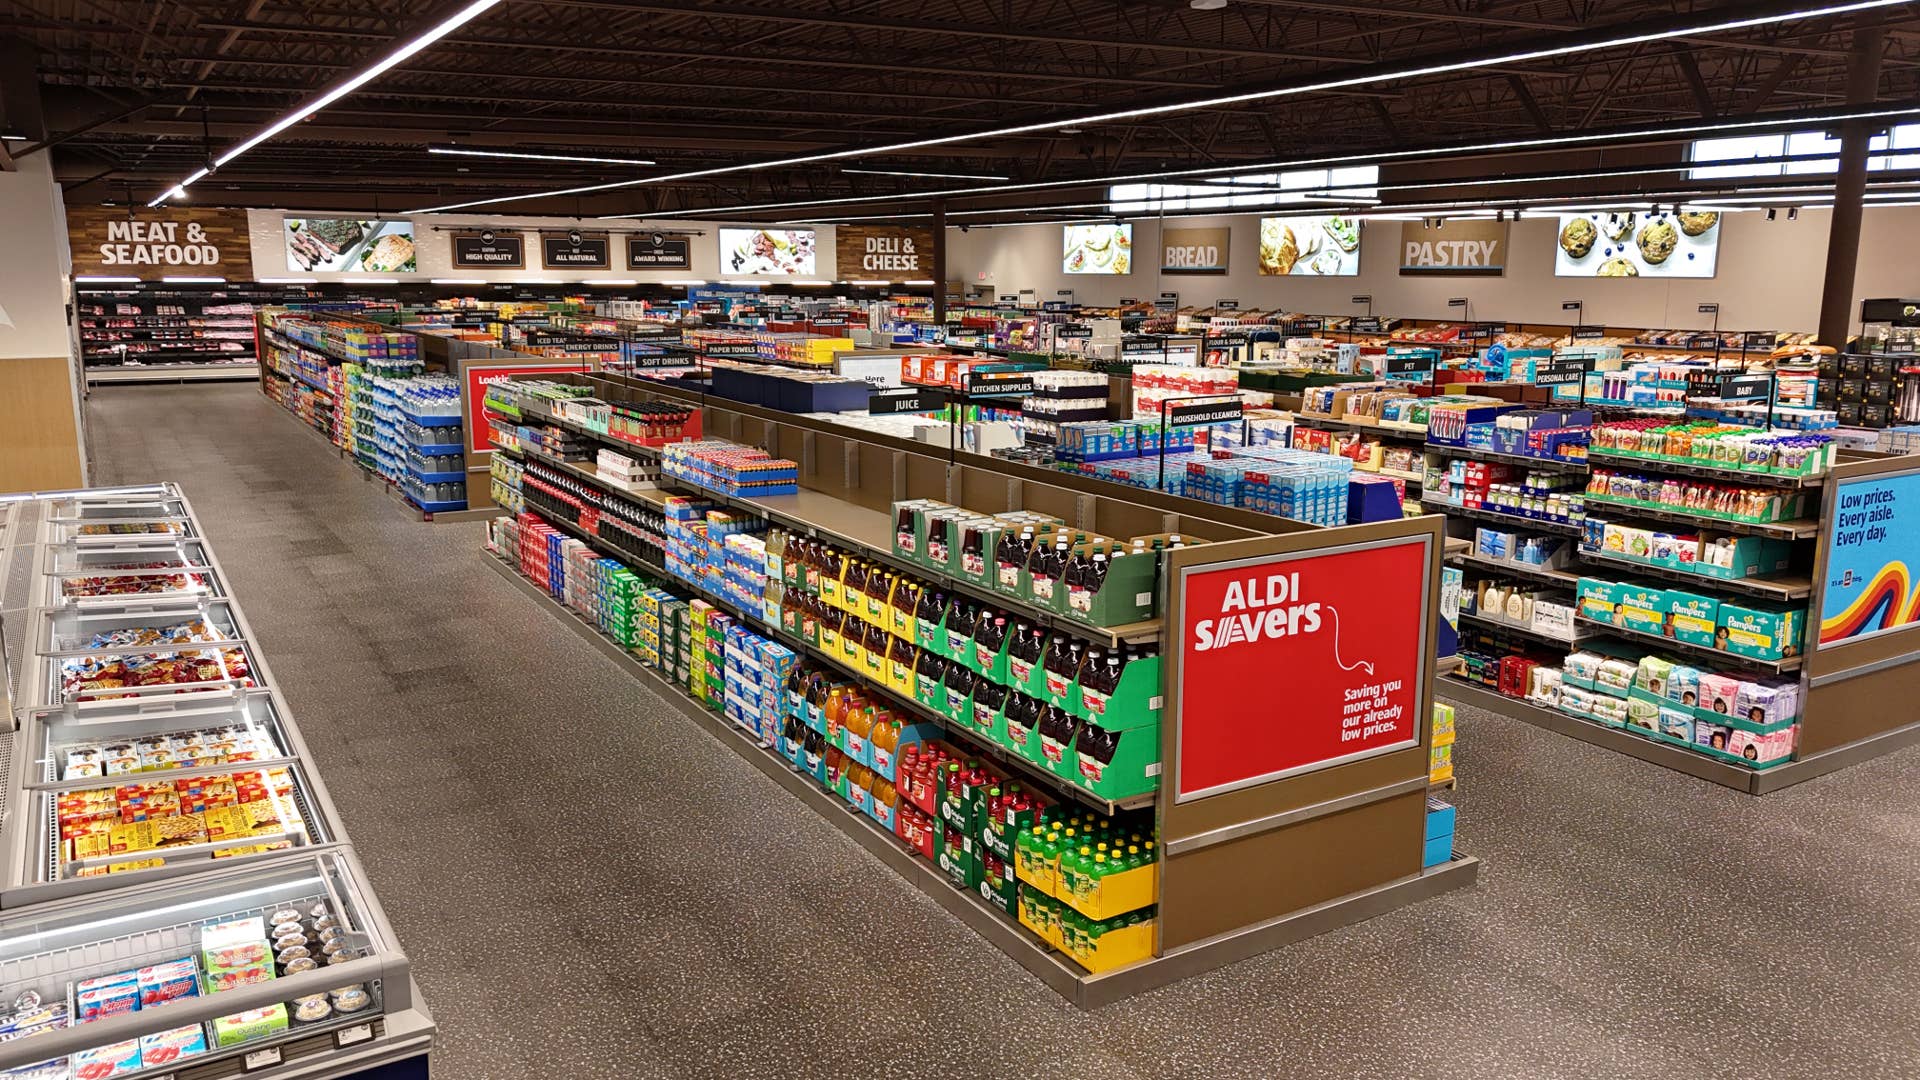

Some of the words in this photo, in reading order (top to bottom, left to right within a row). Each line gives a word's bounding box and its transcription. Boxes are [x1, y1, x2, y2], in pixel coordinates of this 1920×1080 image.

[108, 222, 178, 242] MEAT
[186, 222, 208, 243] &
[866, 237, 899, 254] DELI
[903, 237, 915, 254] &
[1405, 240, 1497, 267] PASTRY
[100, 244, 219, 265] SEAFOOD
[465, 253, 482, 261] HIGH
[483, 253, 512, 262] QUALITY
[568, 254, 597, 262] NATURAL
[657, 255, 684, 263] WINNING
[863, 255, 919, 271] CHEESE
[1166, 246, 1218, 267] BREAD
[566, 344, 593, 352] ENERGY
[593, 343, 618, 351] DRINKS
[709, 346, 730, 354] PAPER
[731, 344, 756, 353] TOWELS
[1141, 342, 1158, 350] TISSUE
[642, 358, 660, 366] SOFT
[661, 357, 689, 365] DRINKS
[1404, 362, 1415, 371] PET
[1537, 373, 1564, 383] PERSONAL
[1565, 372, 1579, 381] CARE
[972, 384, 1001, 393] KITCHEN
[1001, 382, 1032, 392] SUPPLIES
[1736, 386, 1753, 396] BABY
[895, 399, 919, 411] JUICE
[1173, 413, 1211, 424] HOUSEHOLD
[1211, 409, 1241, 421] CLEANERS
[1841, 494, 1863, 509] Low
[1864, 487, 1896, 507] prices.
[1839, 512, 1867, 529] Every
[1868, 505, 1894, 522] aisle.
[1836, 530, 1865, 547] Every
[1866, 525, 1887, 543] day.
[1221, 572, 1300, 613] ALDI
[1623, 593, 1654, 610] Pampers
[1671, 601, 1706, 618] Pampers
[1727, 615, 1762, 633] Pampers
[1344, 684, 1380, 701] Saving
[1382, 679, 1402, 697] you
[1343, 699, 1371, 715] more
[1373, 696, 1388, 708] on
[1342, 715, 1361, 729] our
[1363, 704, 1403, 724] already
[1341, 728, 1361, 742] low
[1363, 720, 1397, 740] prices.
